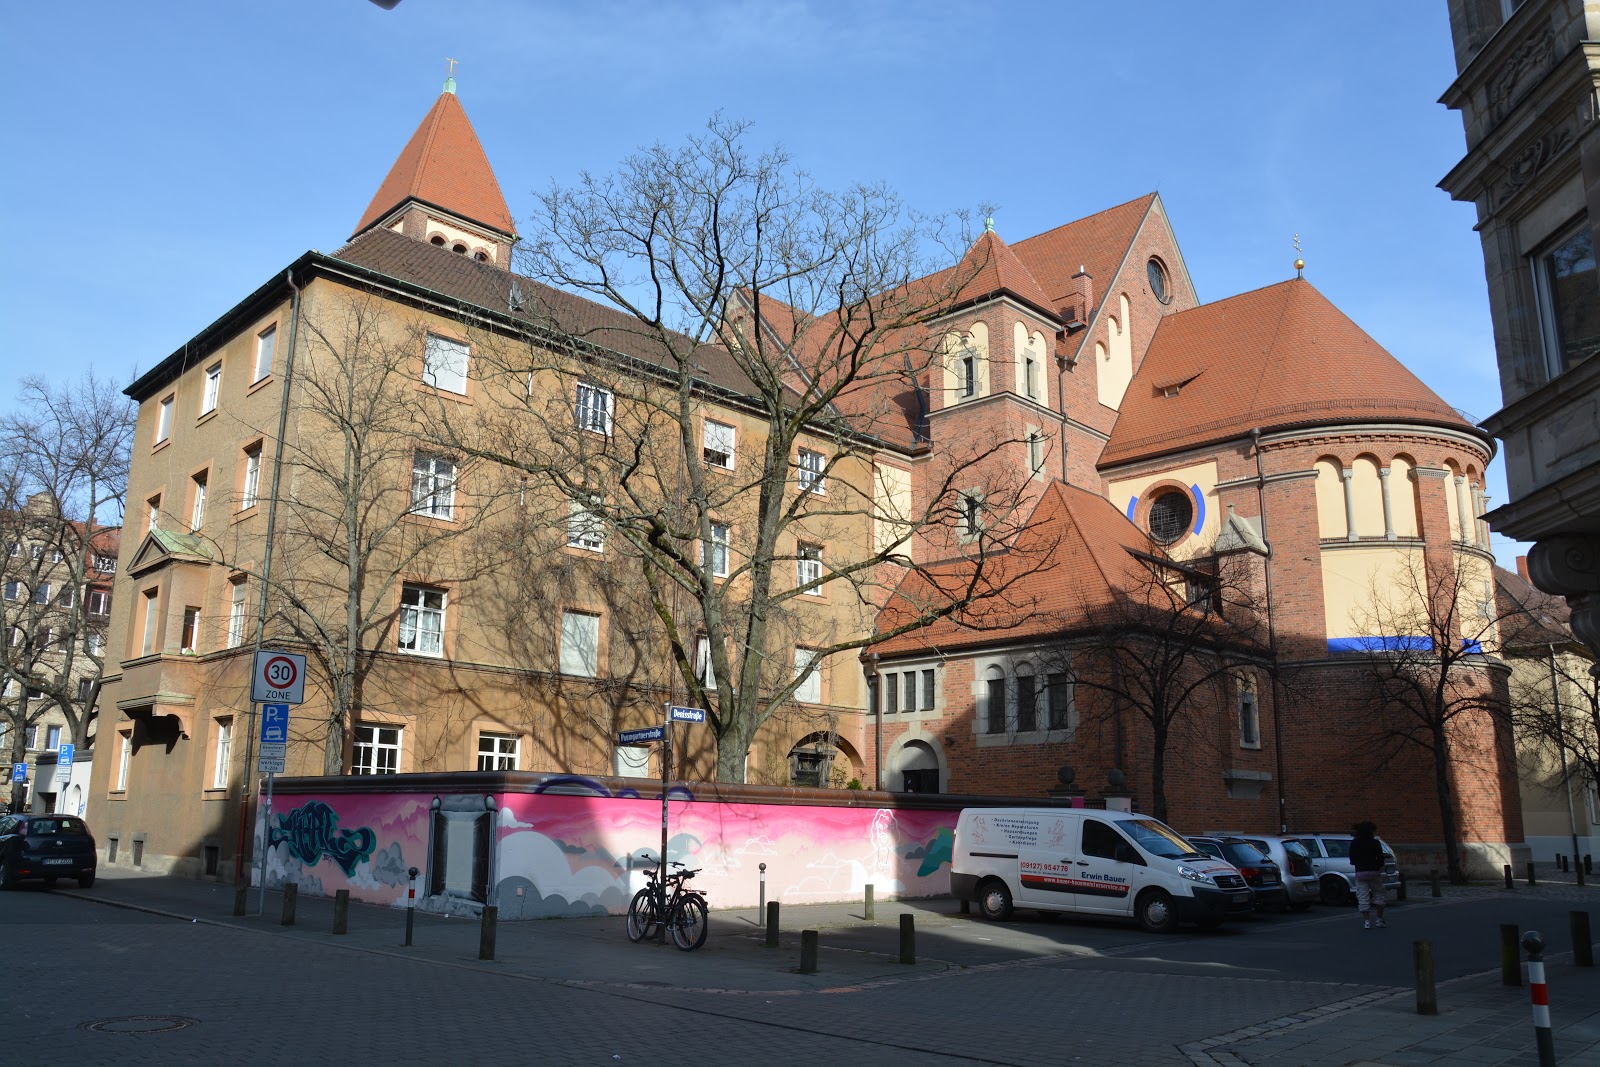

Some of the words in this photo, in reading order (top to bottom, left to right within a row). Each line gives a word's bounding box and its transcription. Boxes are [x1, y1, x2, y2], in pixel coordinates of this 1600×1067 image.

[270, 664, 290, 681] 30
[265, 690, 291, 700] ZONE
[266, 706, 279, 722] P
[673, 708, 702, 721] Denisstraße
[1081, 871, 1103, 881] Erwin
[1103, 873, 1126, 883] Bauer
